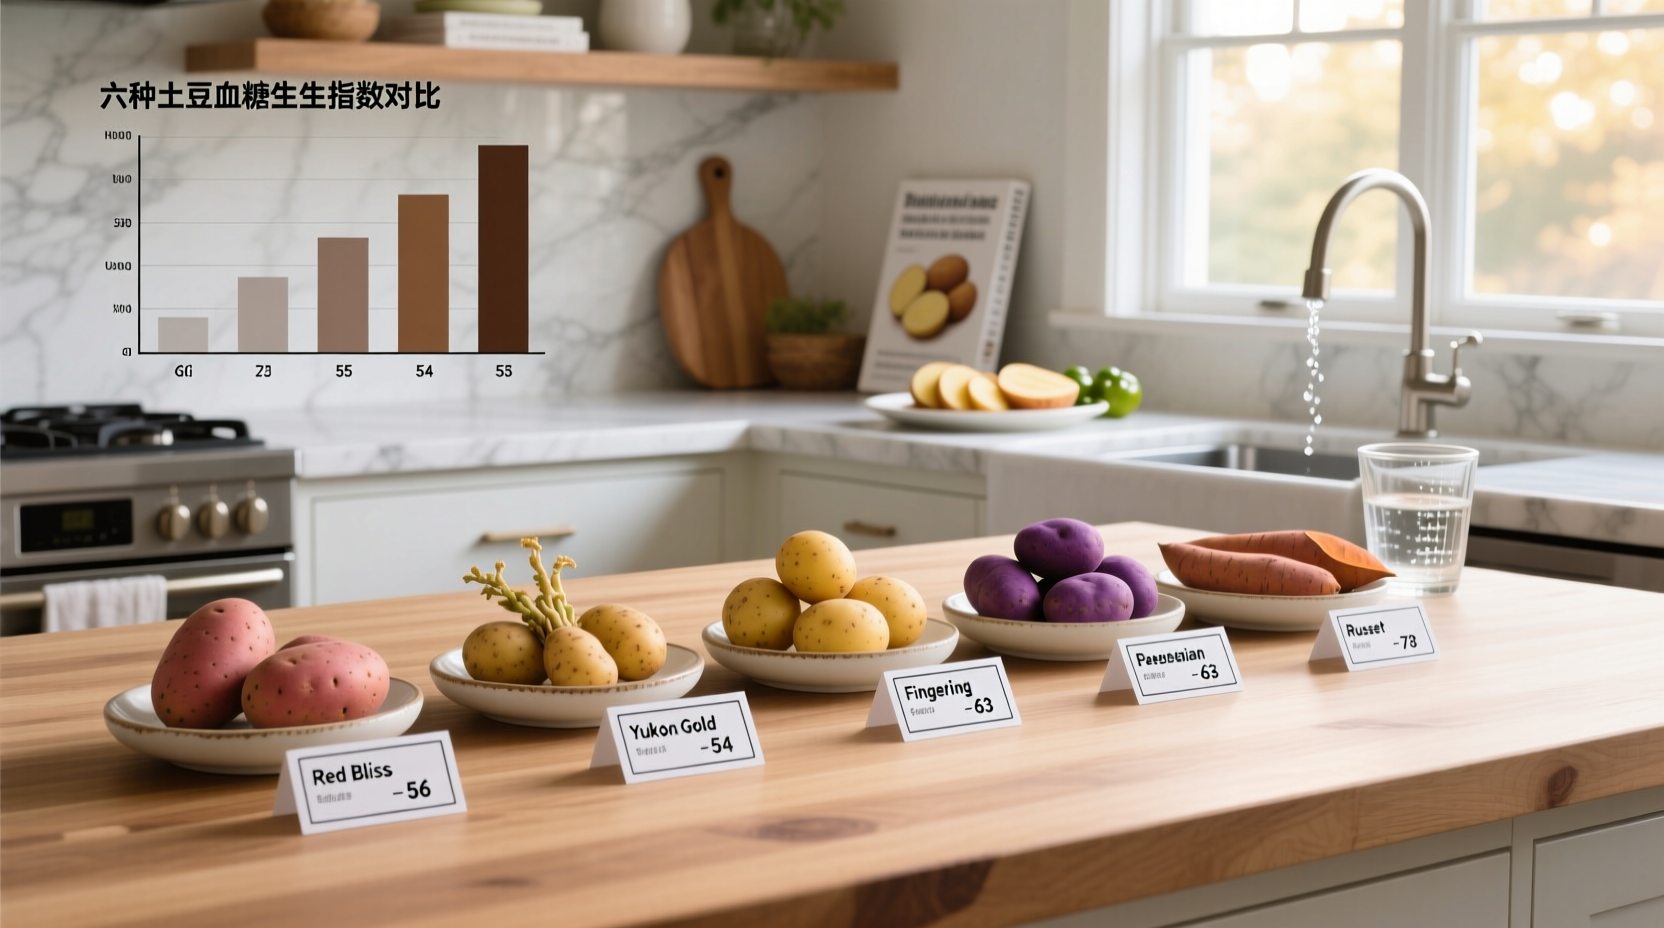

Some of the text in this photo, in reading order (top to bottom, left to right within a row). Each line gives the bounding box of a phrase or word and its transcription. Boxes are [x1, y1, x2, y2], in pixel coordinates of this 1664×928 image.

[1345, 620, 1386, 638] Russet
[629, 715, 717, 740] Yukon Gold
[312, 762, 393, 786] Red Bliss
